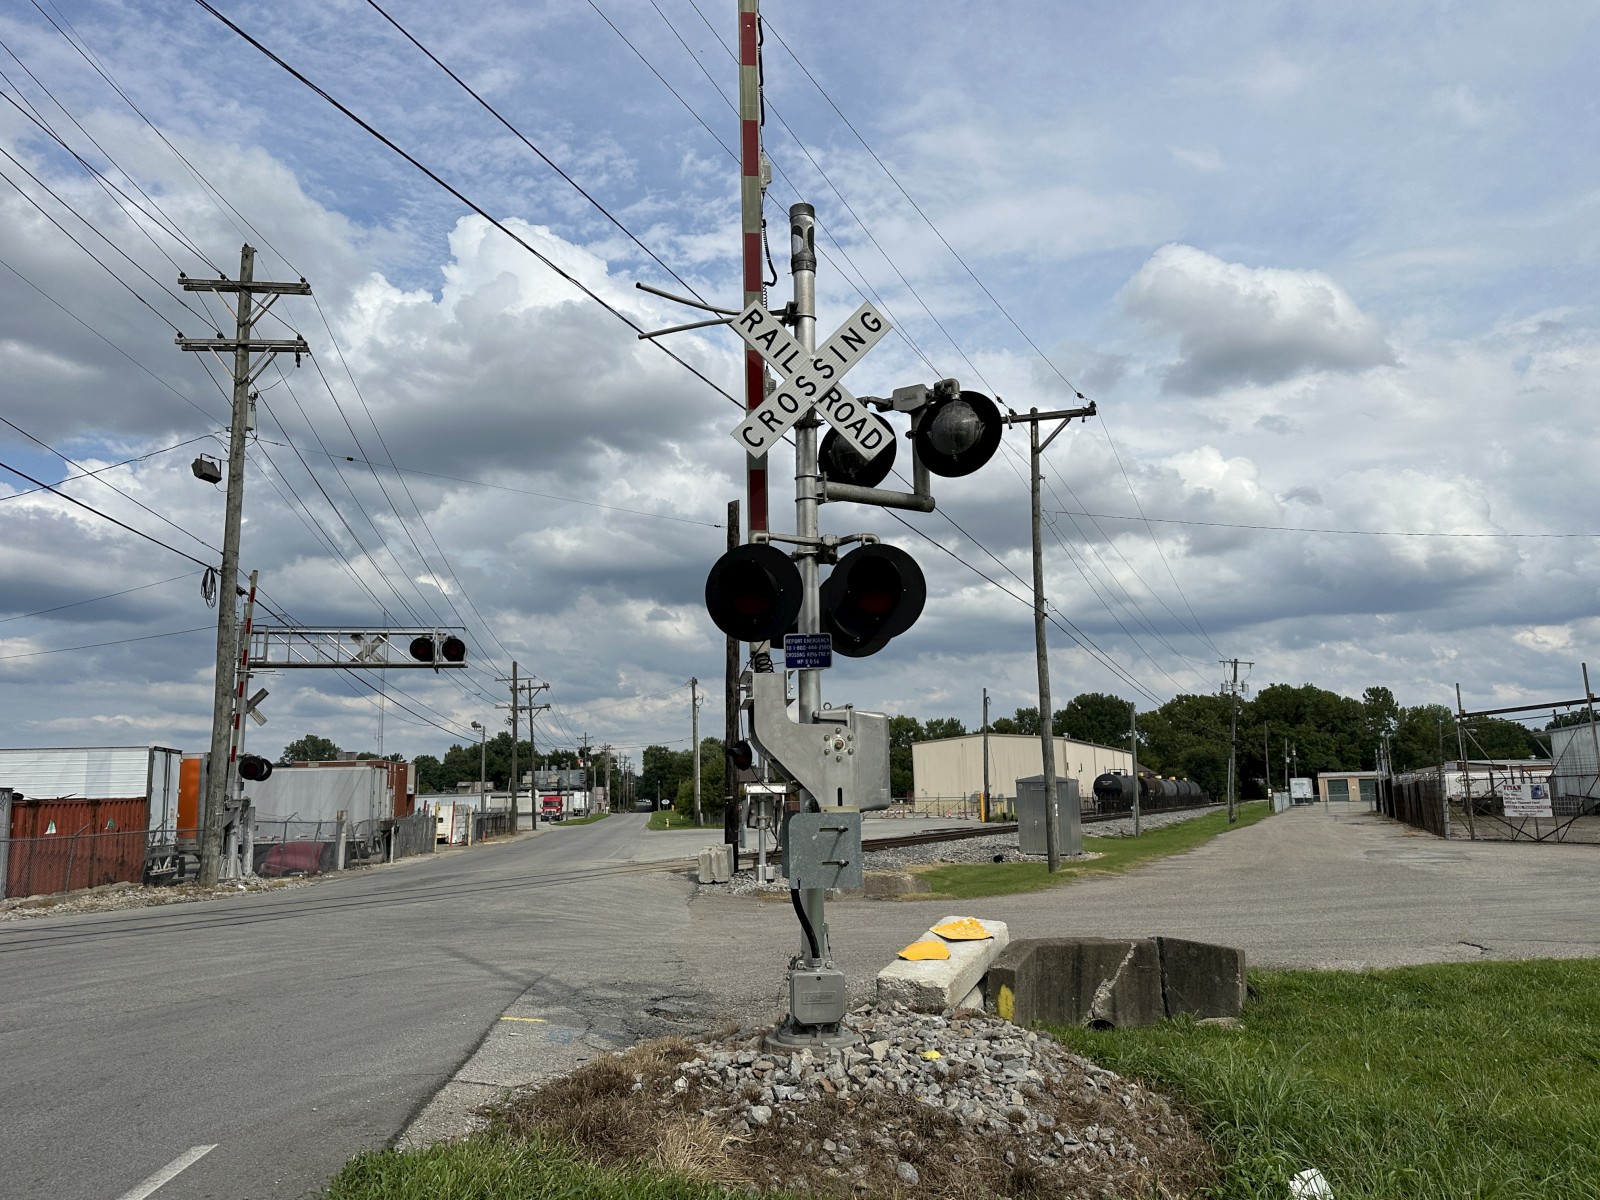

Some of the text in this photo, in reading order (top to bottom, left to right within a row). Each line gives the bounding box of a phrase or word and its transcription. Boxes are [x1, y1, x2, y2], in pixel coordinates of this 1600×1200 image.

[740, 308, 883, 450] RAIL ROAD
[742, 311, 882, 447] CROSSING
